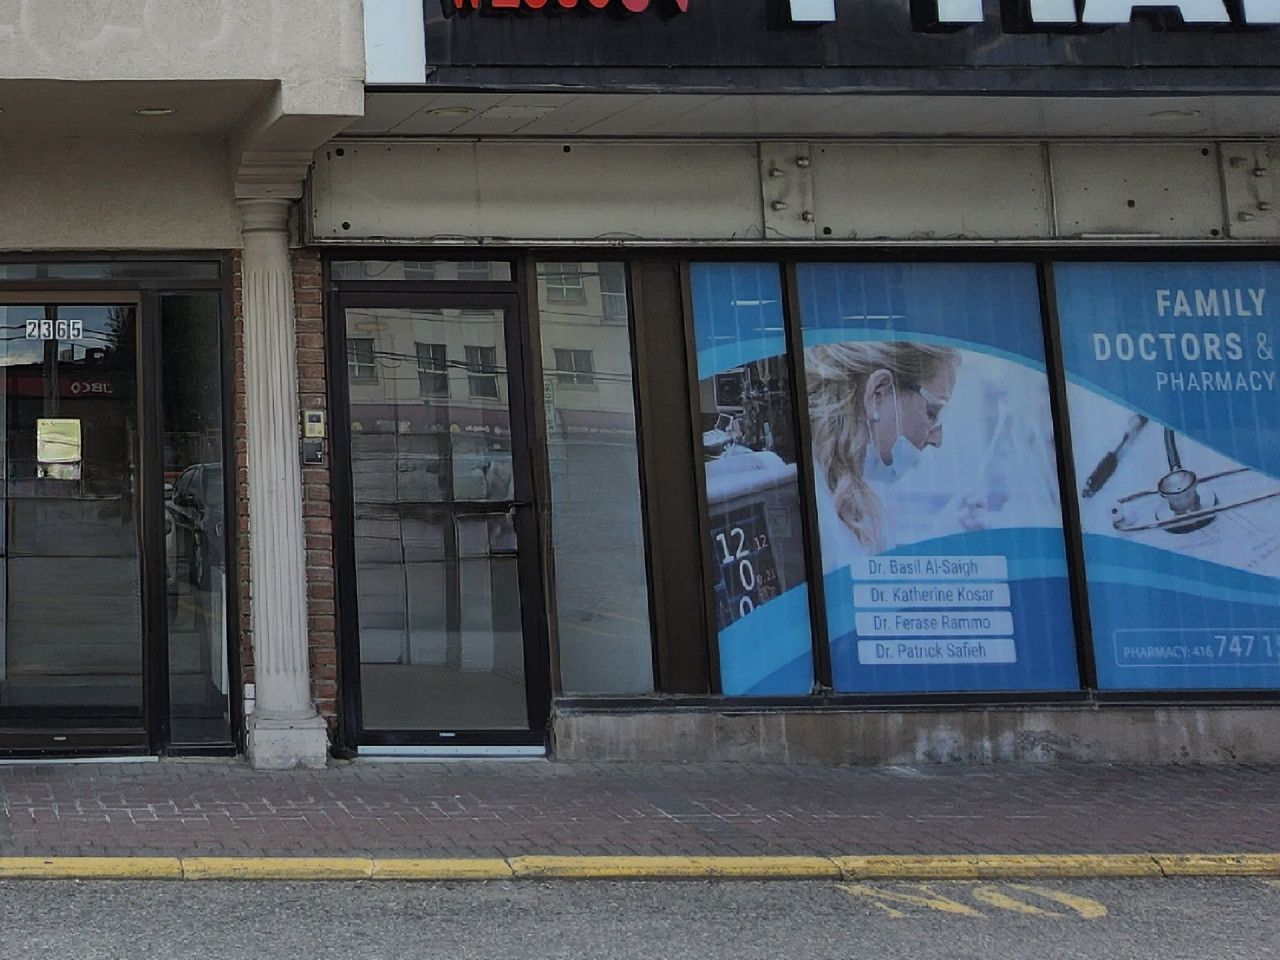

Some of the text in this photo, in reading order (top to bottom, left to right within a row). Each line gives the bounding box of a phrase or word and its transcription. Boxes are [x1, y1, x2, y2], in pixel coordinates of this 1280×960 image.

[1156, 288, 1266, 318] FAMILY
[27, 321, 82, 339] 2365
[1093, 332, 1274, 361] DOCTORS &
[1156, 372, 1275, 391] PHARMACY
[716, 527, 750, 564] 12
[869, 559, 978, 577] Dr. Basil Al-Saigh
[871, 587, 993, 602] Dr. Katherine Kosar
[874, 615, 991, 630] Dr. Ferase Rammo
[876, 643, 987, 658] Dr. Patrick Safieh
[1124, 646, 1190, 659] PHARMACY:
[1214, 635, 1254, 657] 747
